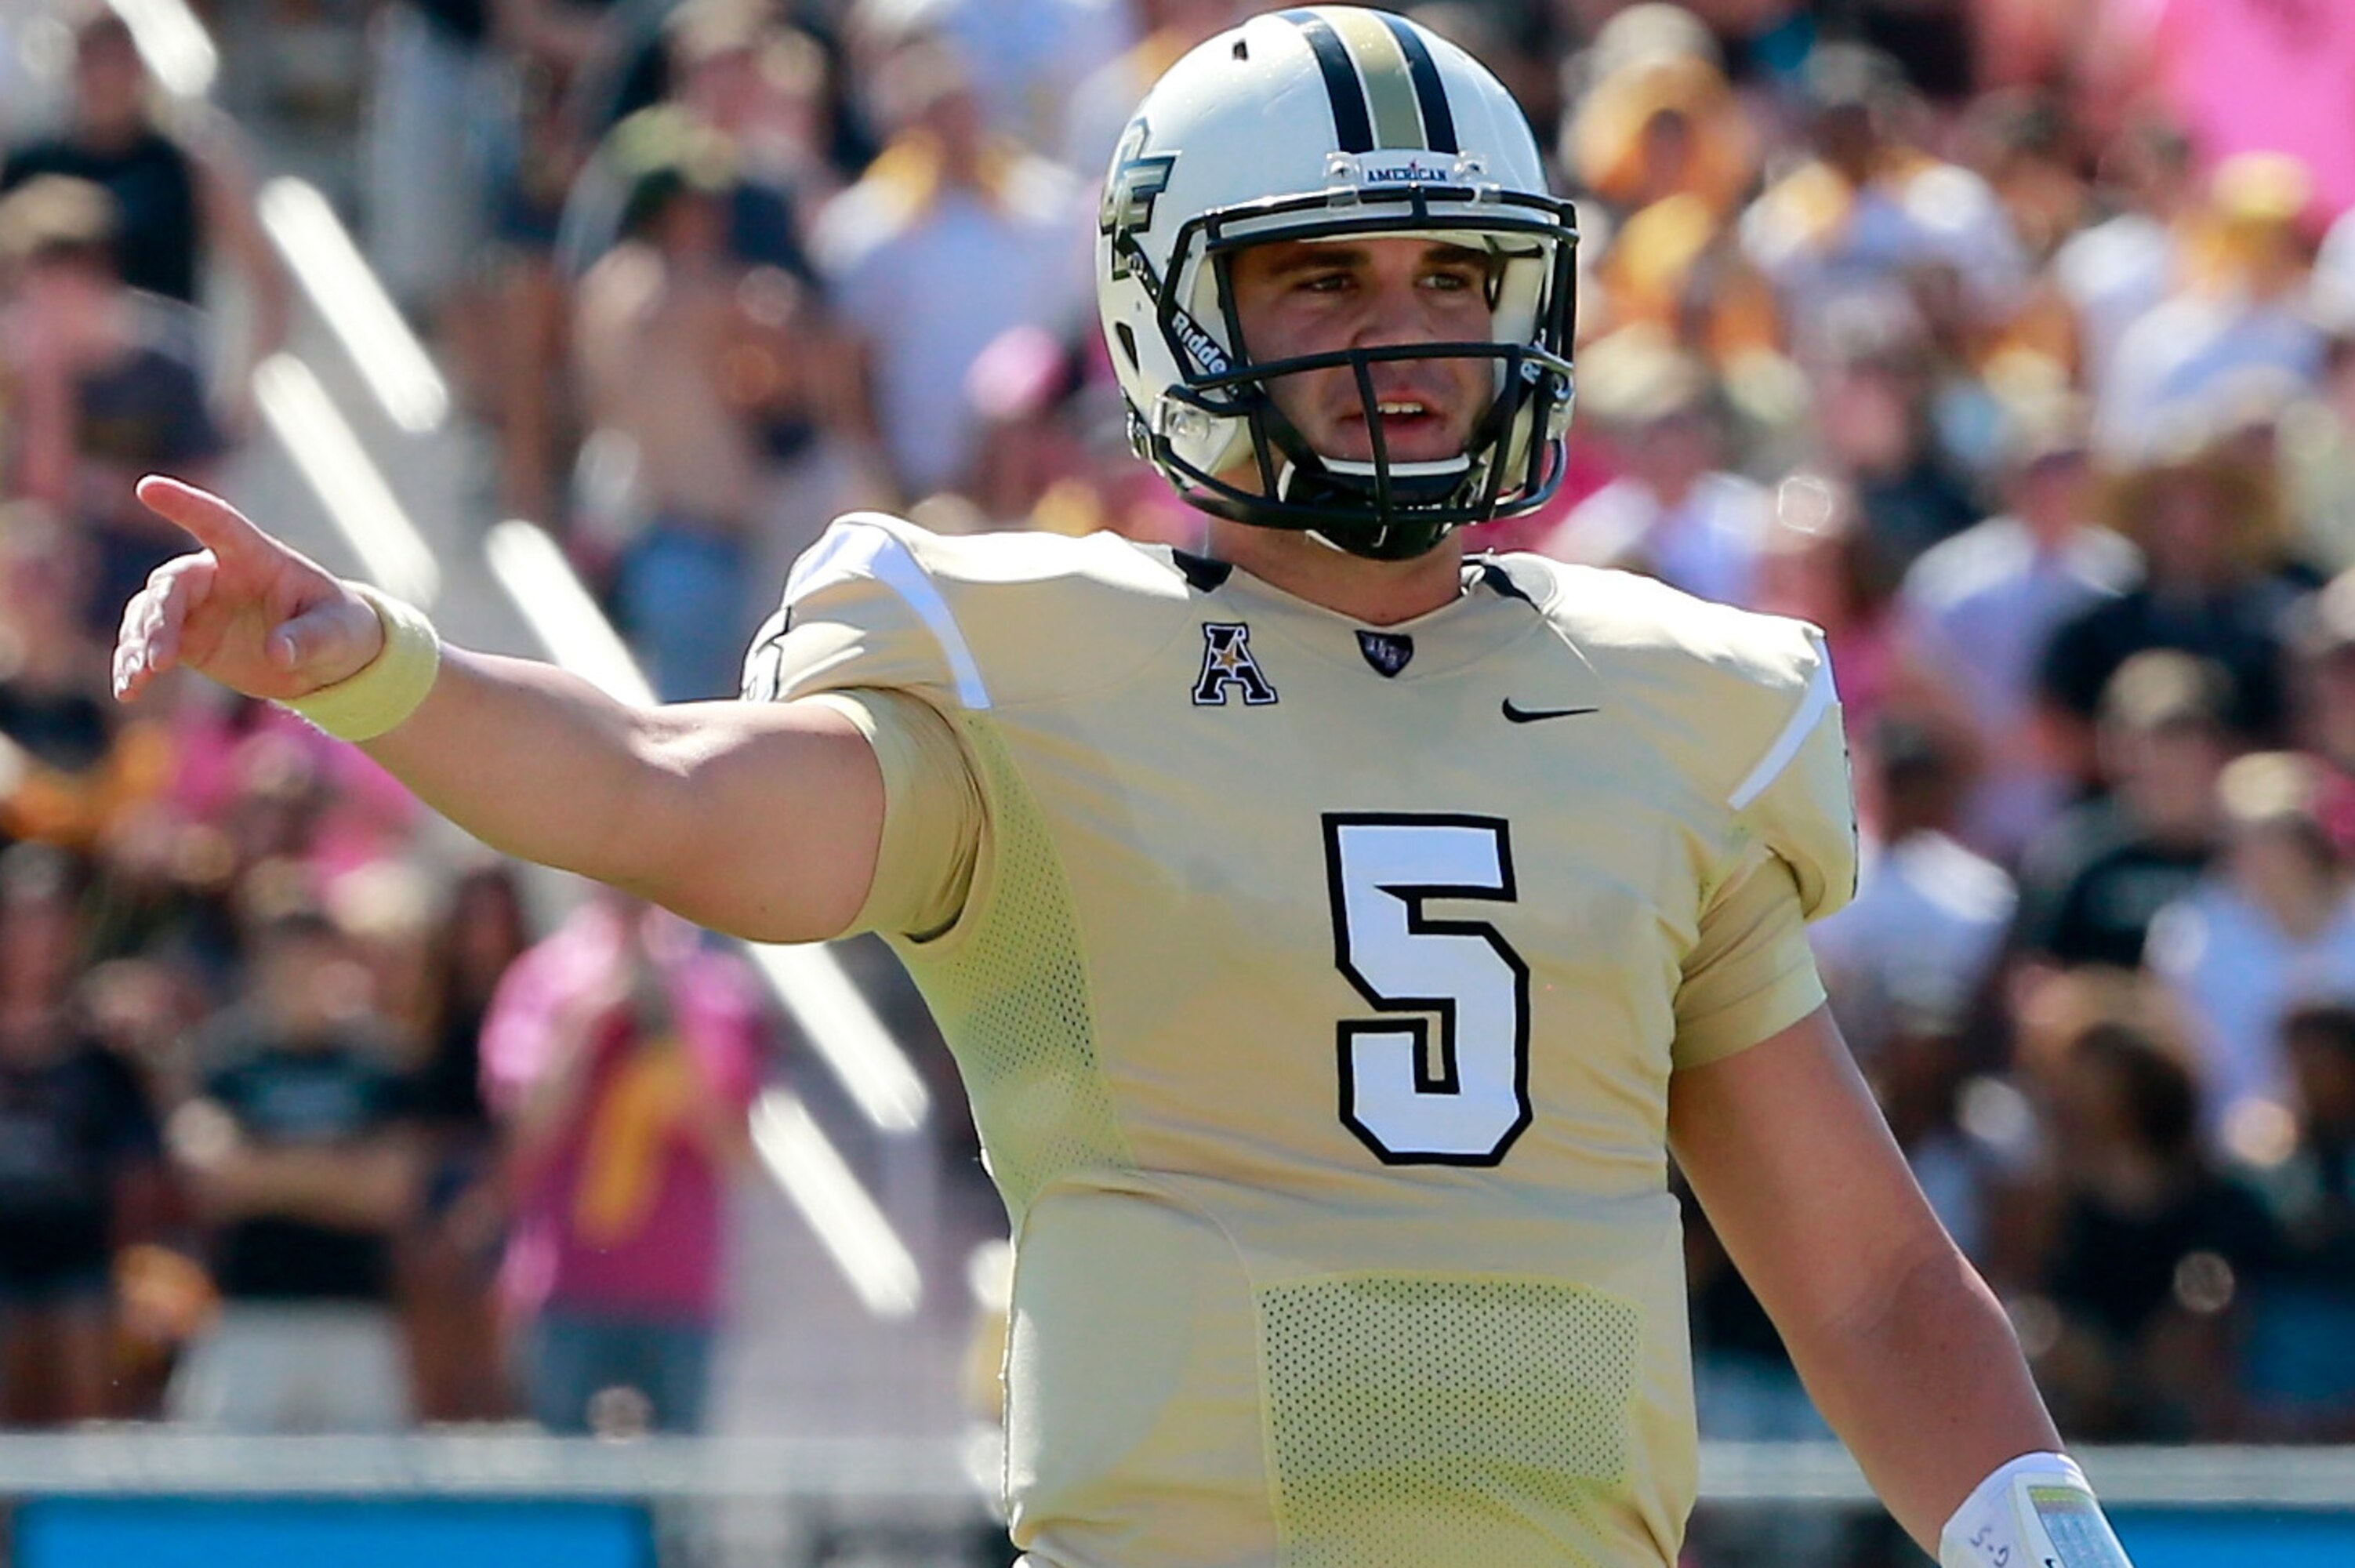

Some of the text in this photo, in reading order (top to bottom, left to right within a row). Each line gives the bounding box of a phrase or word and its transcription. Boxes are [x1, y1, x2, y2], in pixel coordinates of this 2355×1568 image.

[1367, 164, 1447, 183] AMERICAN
[1171, 310, 1228, 375] Ridde
[1192, 622, 1279, 706] A
[1322, 812, 1533, 1167] 5
